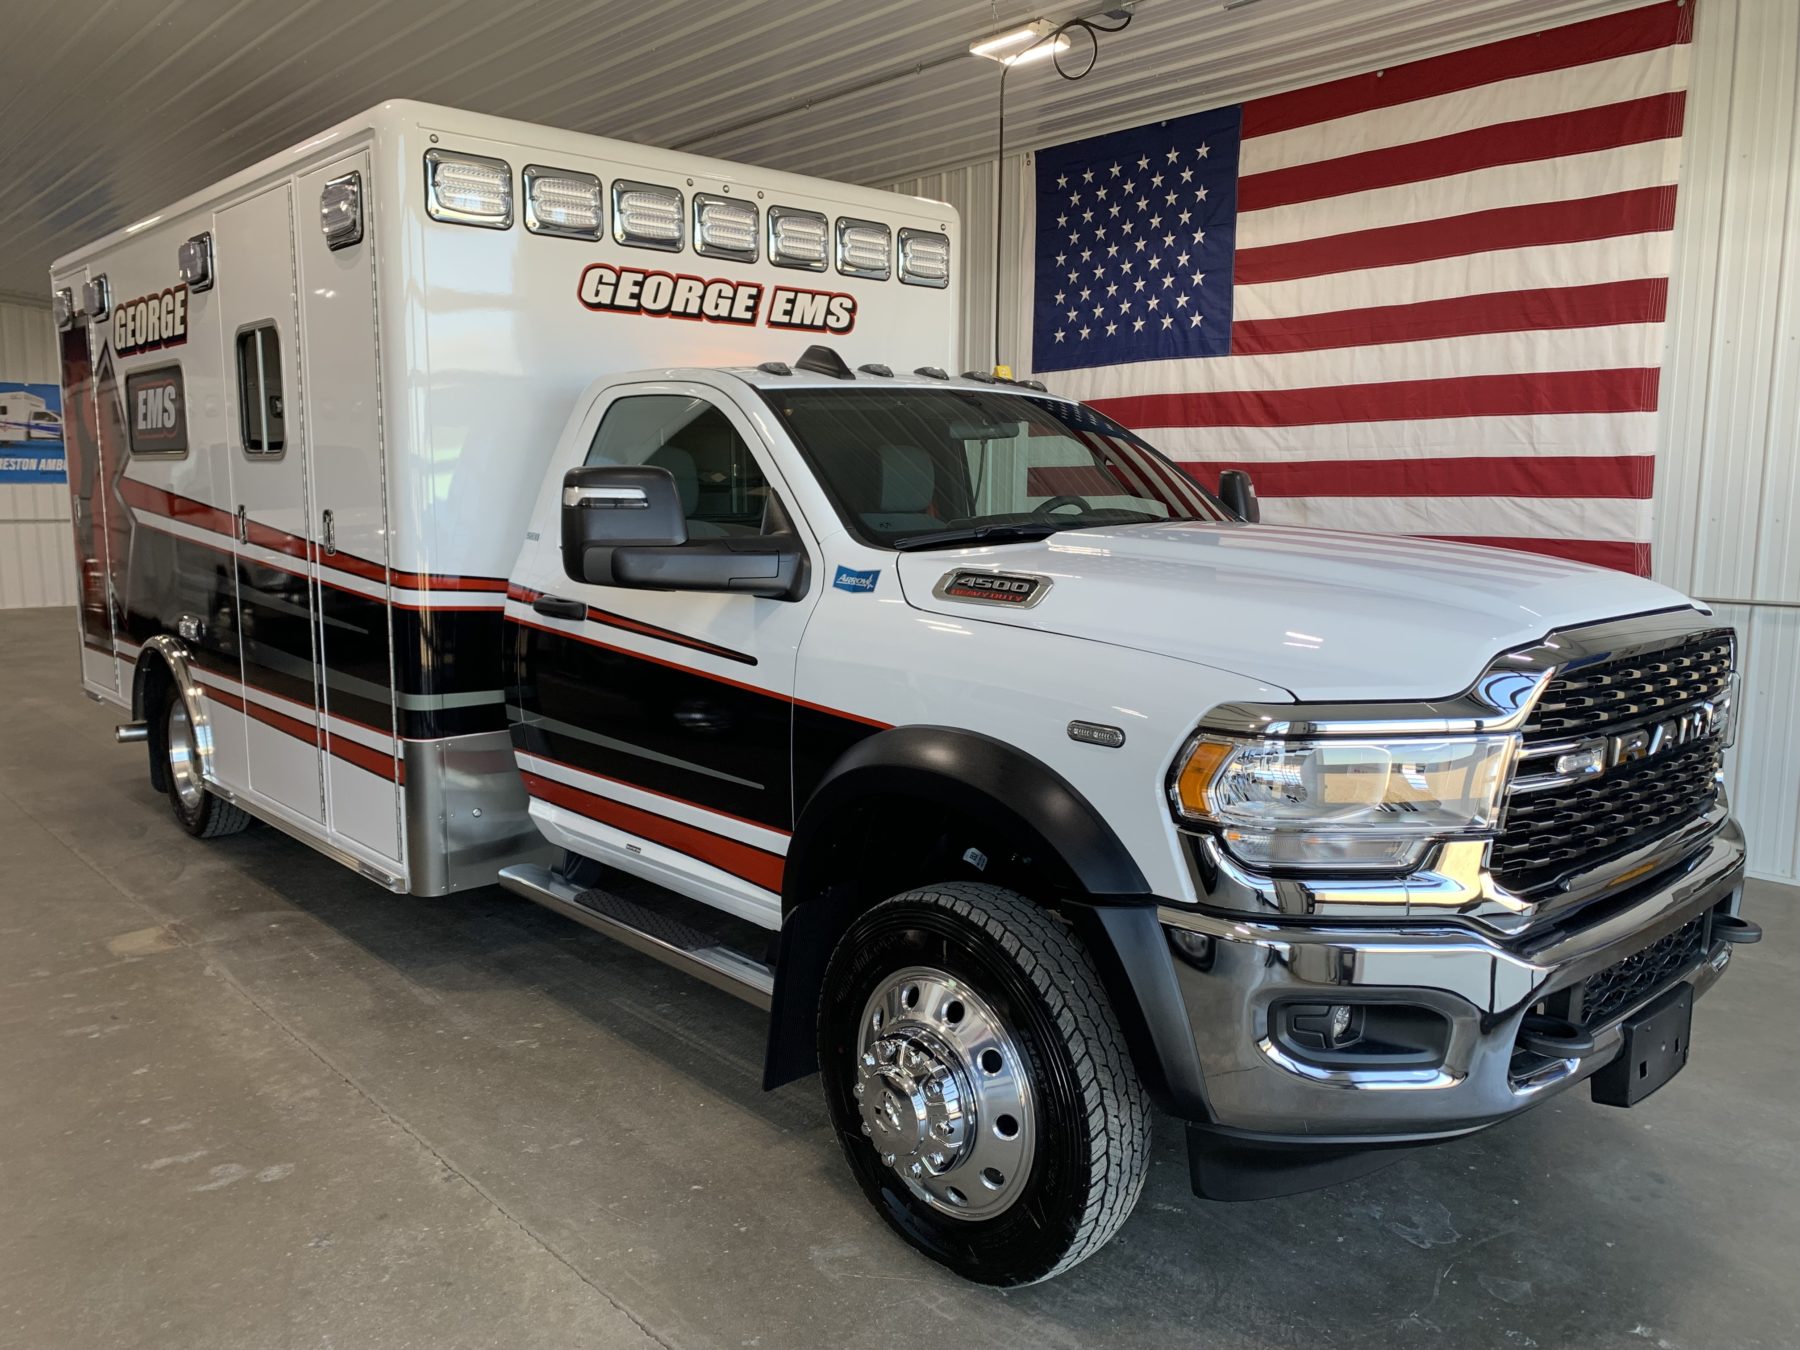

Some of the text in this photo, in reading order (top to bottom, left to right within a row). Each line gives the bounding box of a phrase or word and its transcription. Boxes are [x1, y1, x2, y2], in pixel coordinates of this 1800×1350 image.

[114, 288, 186, 352] GEORGE
[579, 265, 855, 331] GEORGE EMS
[136, 384, 177, 431] EMS
[957, 577, 1030, 594] 4500
[1607, 700, 1714, 768] RAM
